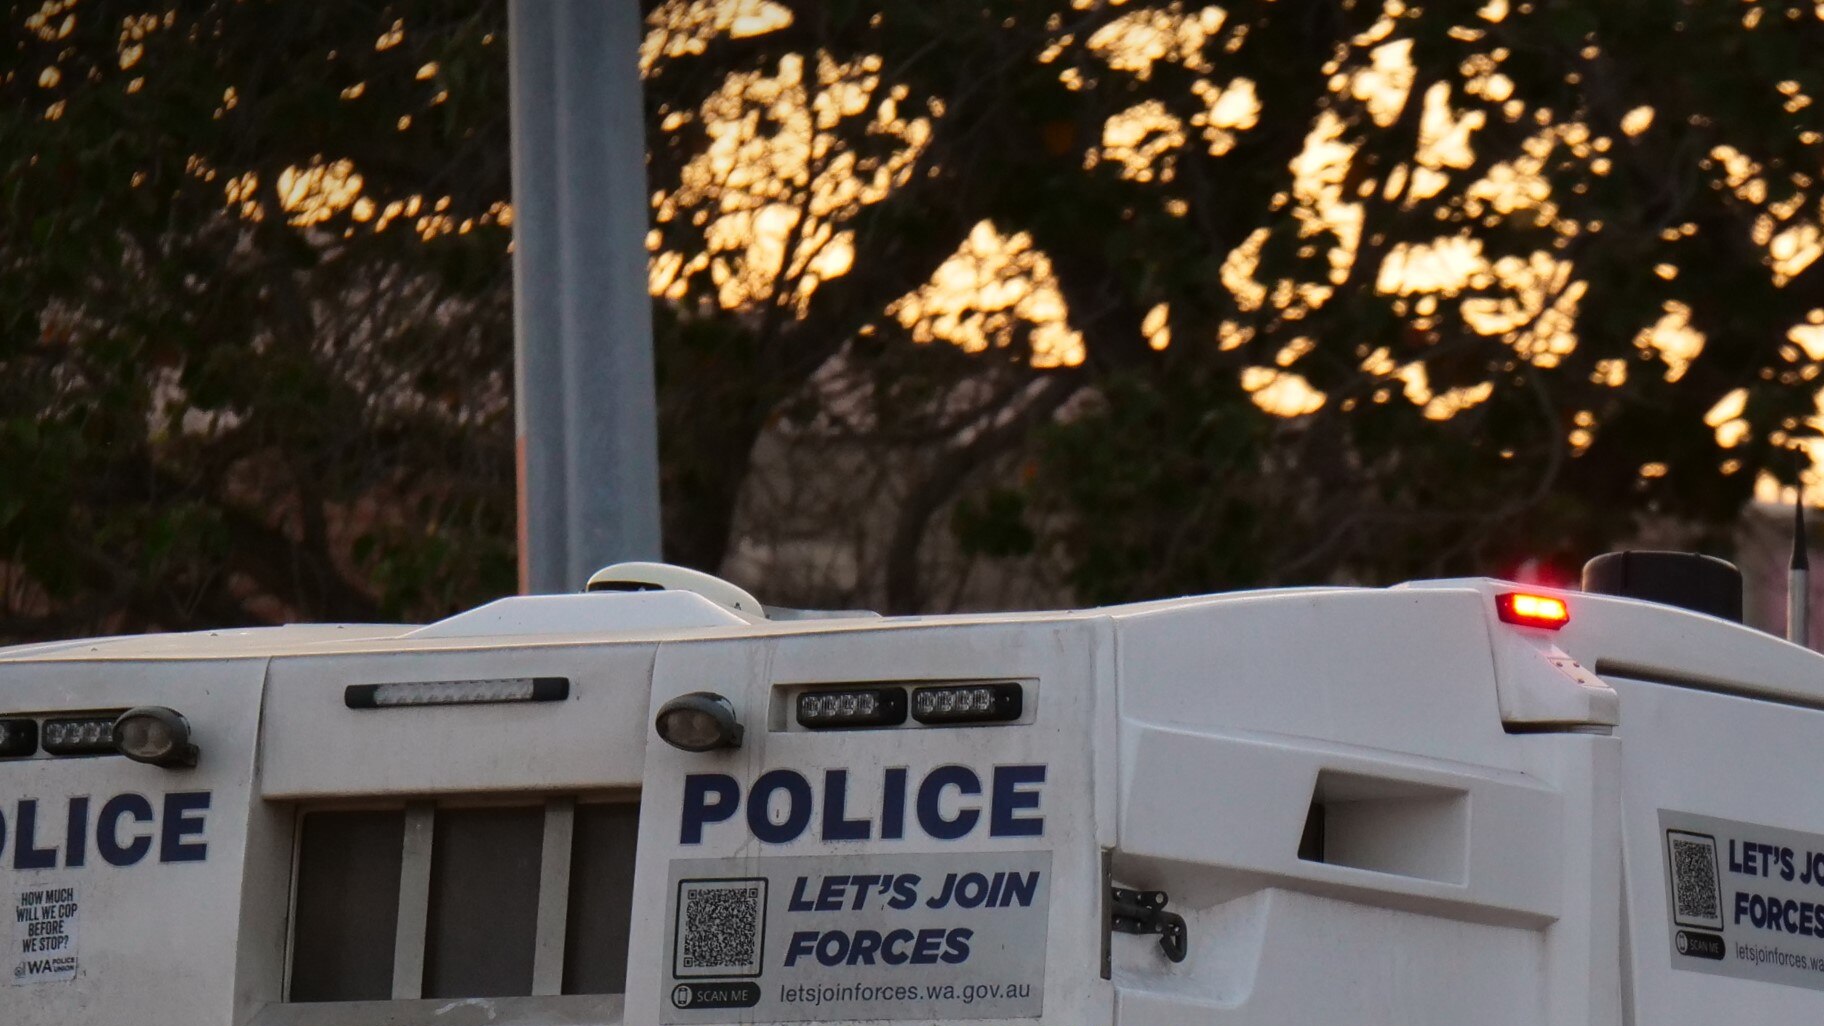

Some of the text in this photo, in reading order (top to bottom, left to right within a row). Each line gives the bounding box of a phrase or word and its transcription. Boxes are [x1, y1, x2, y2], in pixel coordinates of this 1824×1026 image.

[680, 764, 1048, 844] POLICE
[0, 791, 211, 869] LICE
[1728, 838, 1795, 882] LET'S
[21, 887, 73, 906] HOW MUCH
[787, 871, 1040, 912] LET'S JOIN
[16, 903, 78, 922] WILL WE COP
[28, 920, 64, 937] BEFORE
[22, 935, 69, 953] WE STOP?
[783, 927, 974, 967] FORCES
[28, 960, 53, 974] WA
[696, 989, 749, 1002] SCAN ME
[779, 983, 1031, 1006] letsjoinforces.wa.gov.au
